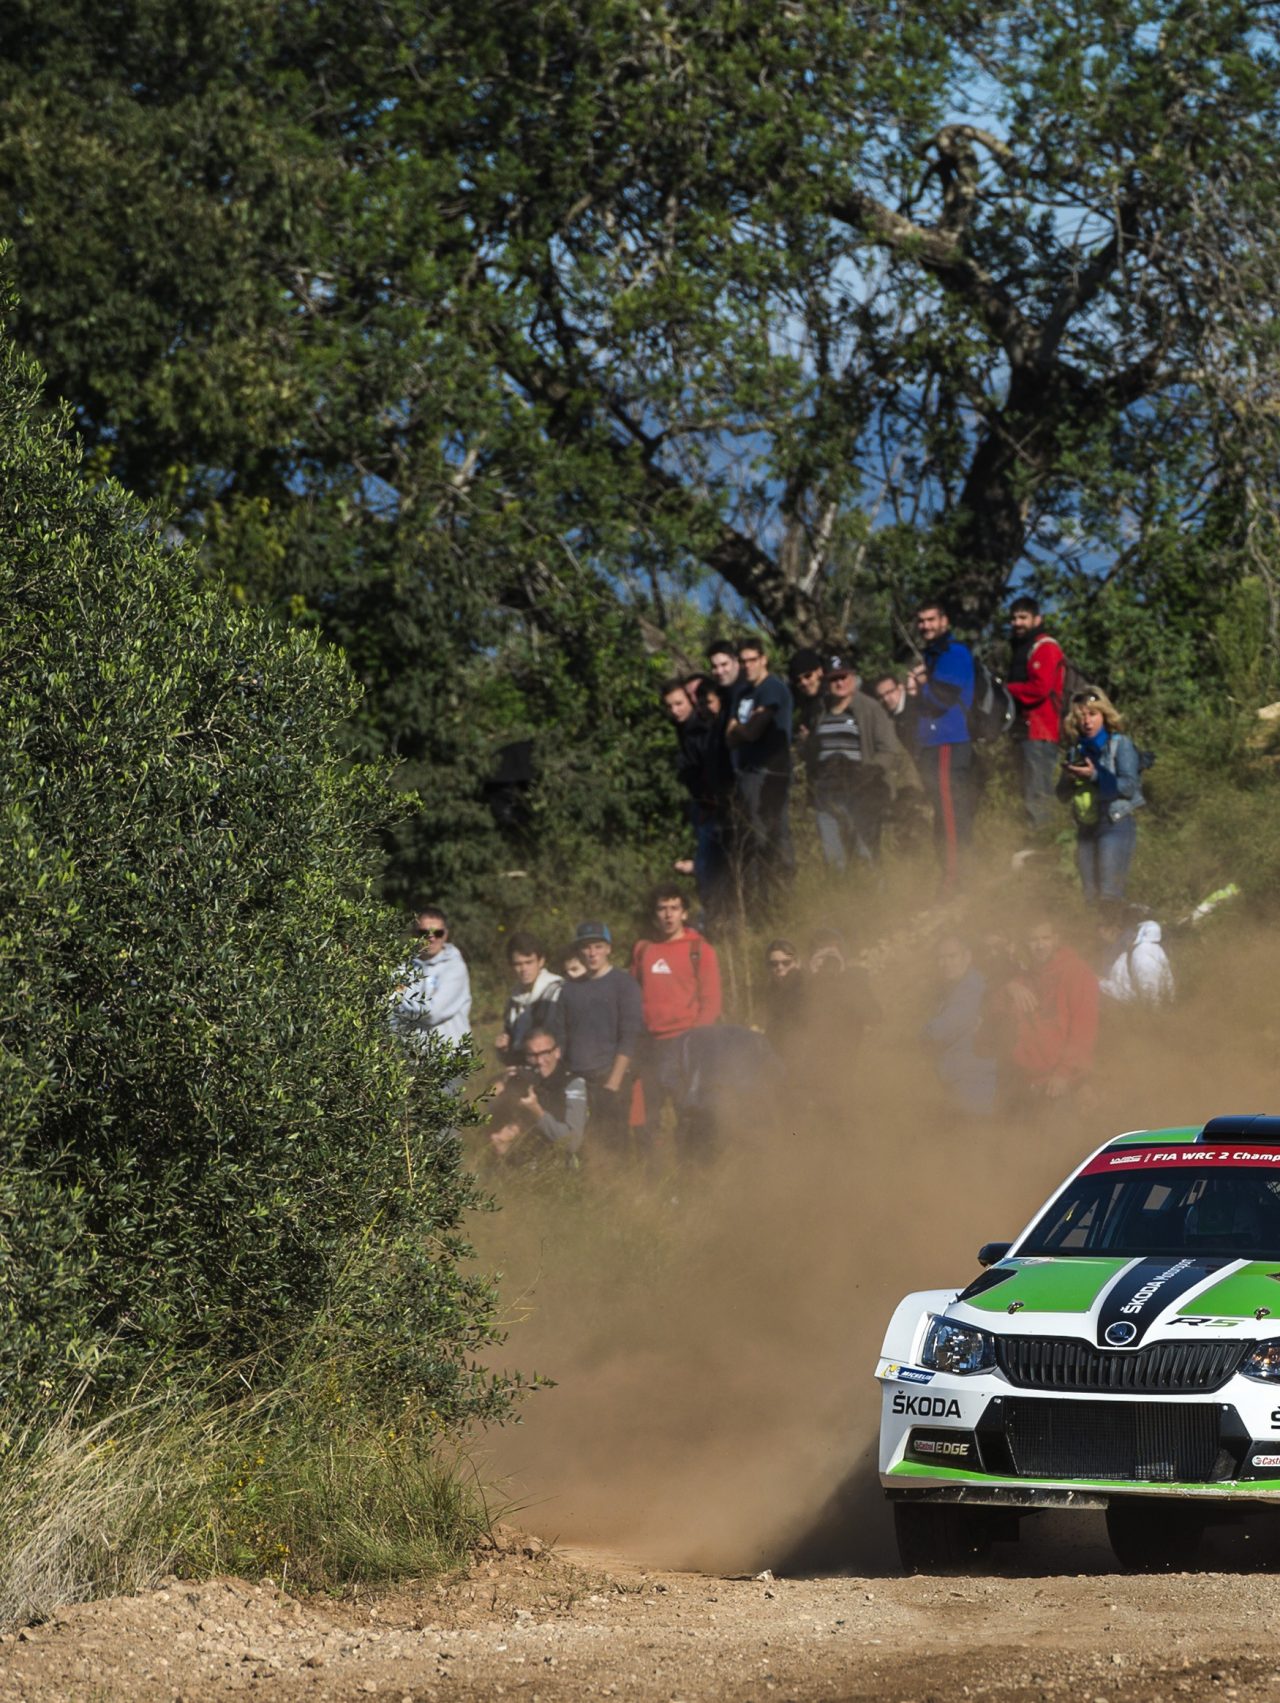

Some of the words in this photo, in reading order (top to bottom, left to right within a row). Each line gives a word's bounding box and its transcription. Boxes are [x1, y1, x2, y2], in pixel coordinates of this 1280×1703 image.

[1153, 1152, 1177, 1162] FIA
[1182, 1151, 1214, 1161] WRC
[1218, 1151, 1229, 1160] 2
[1120, 1279, 1167, 1314] ŠKODA
[1165, 1317, 1245, 1328] R5
[901, 1370, 933, 1381] MICHELIN
[892, 1390, 962, 1419] ŠKODA
[935, 1442, 970, 1456] EDGE
